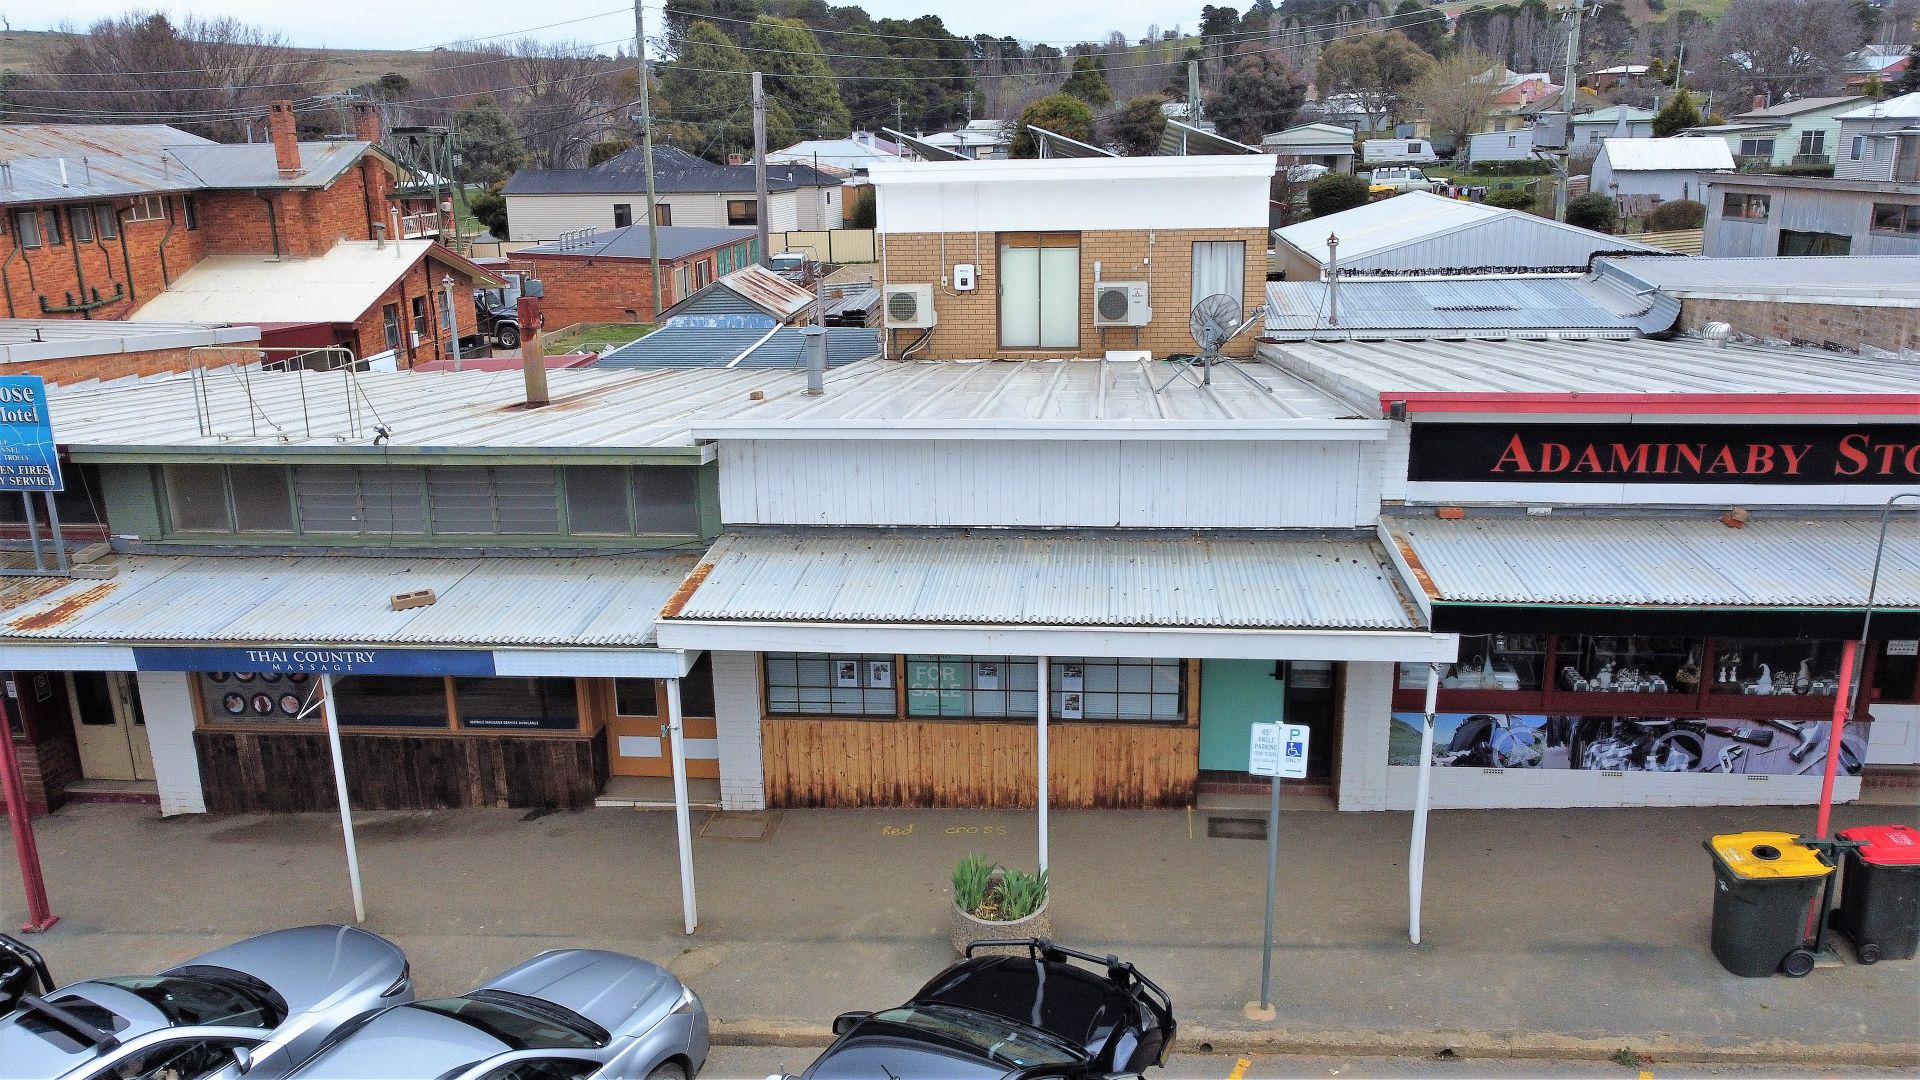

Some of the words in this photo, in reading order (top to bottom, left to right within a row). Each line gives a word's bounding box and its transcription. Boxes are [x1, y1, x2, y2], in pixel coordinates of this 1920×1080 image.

[1490, 433, 1814, 475] ADAMINABY
[19, 465, 50, 475] FIRES
[246, 650, 288, 662] THAI
[293, 651, 376, 663] COUNTRY
[272, 663, 353, 671] MASSAGE
[916, 666, 956, 681] FOR
[911, 682, 961, 698] SALE
[1290, 729, 1301, 741] P
[1254, 743, 1278, 751] PARKING
[883, 824, 914, 836] Red
